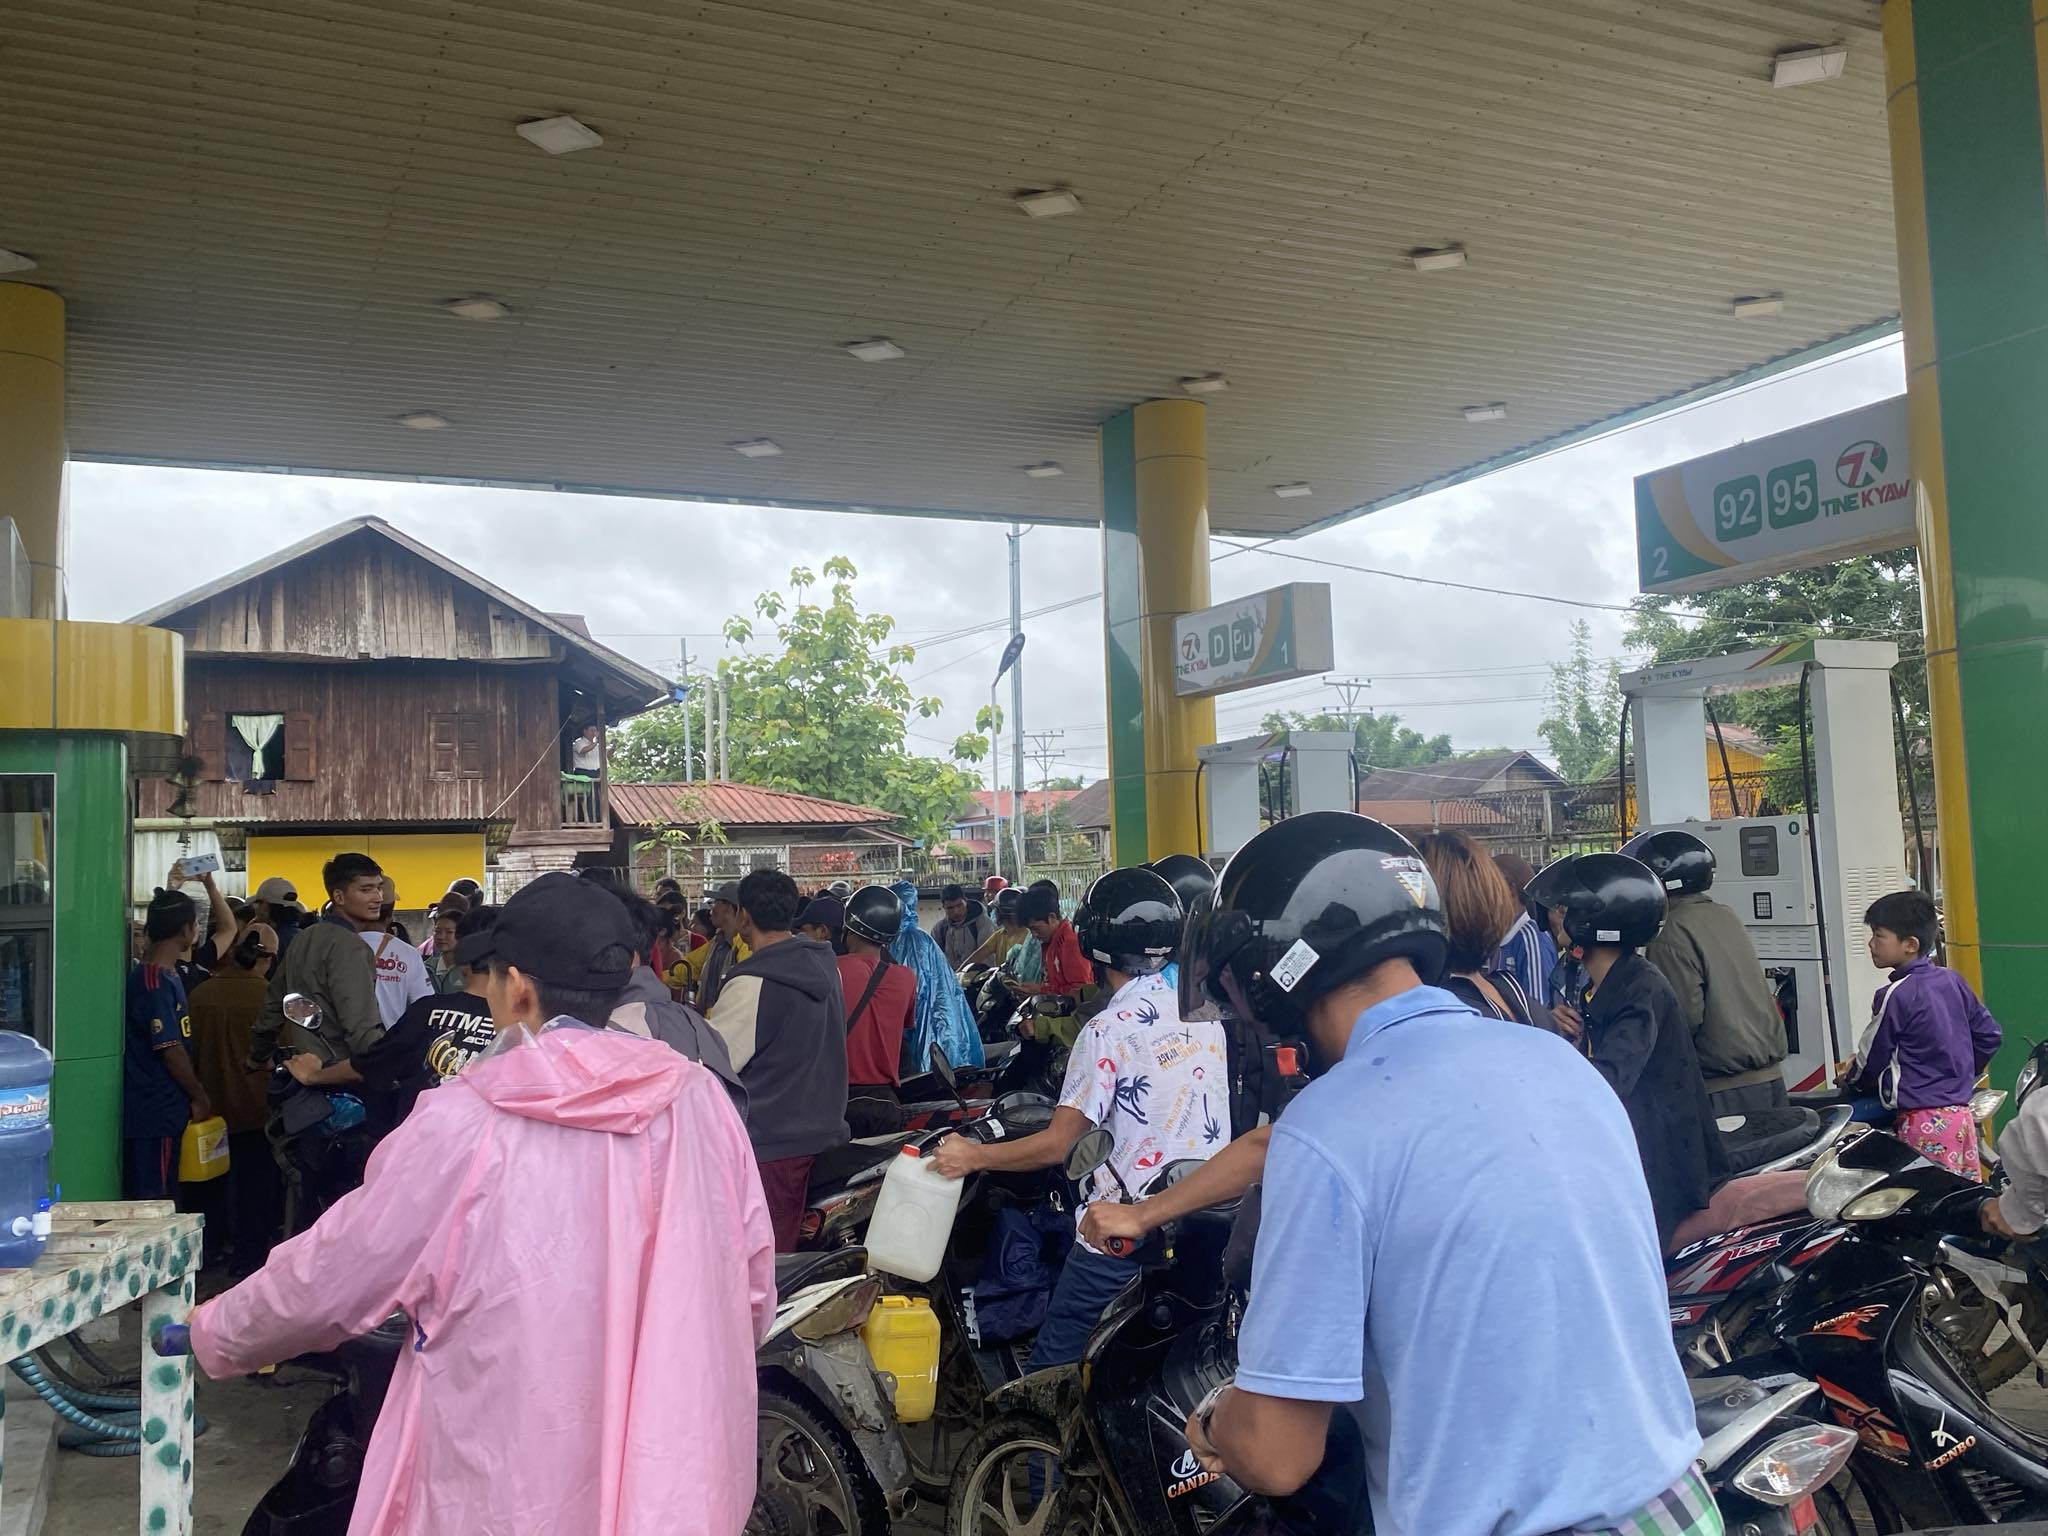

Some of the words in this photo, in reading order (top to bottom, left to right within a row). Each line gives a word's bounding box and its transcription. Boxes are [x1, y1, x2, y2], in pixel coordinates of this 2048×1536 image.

[1719, 488, 1757, 529] 92
[1772, 472, 1813, 516] 95
[1653, 547, 1669, 579] 2
[1281, 641, 1288, 665] 1
[428, 1009, 497, 1036] FITME
[1923, 1434, 1977, 1471] KENBO
